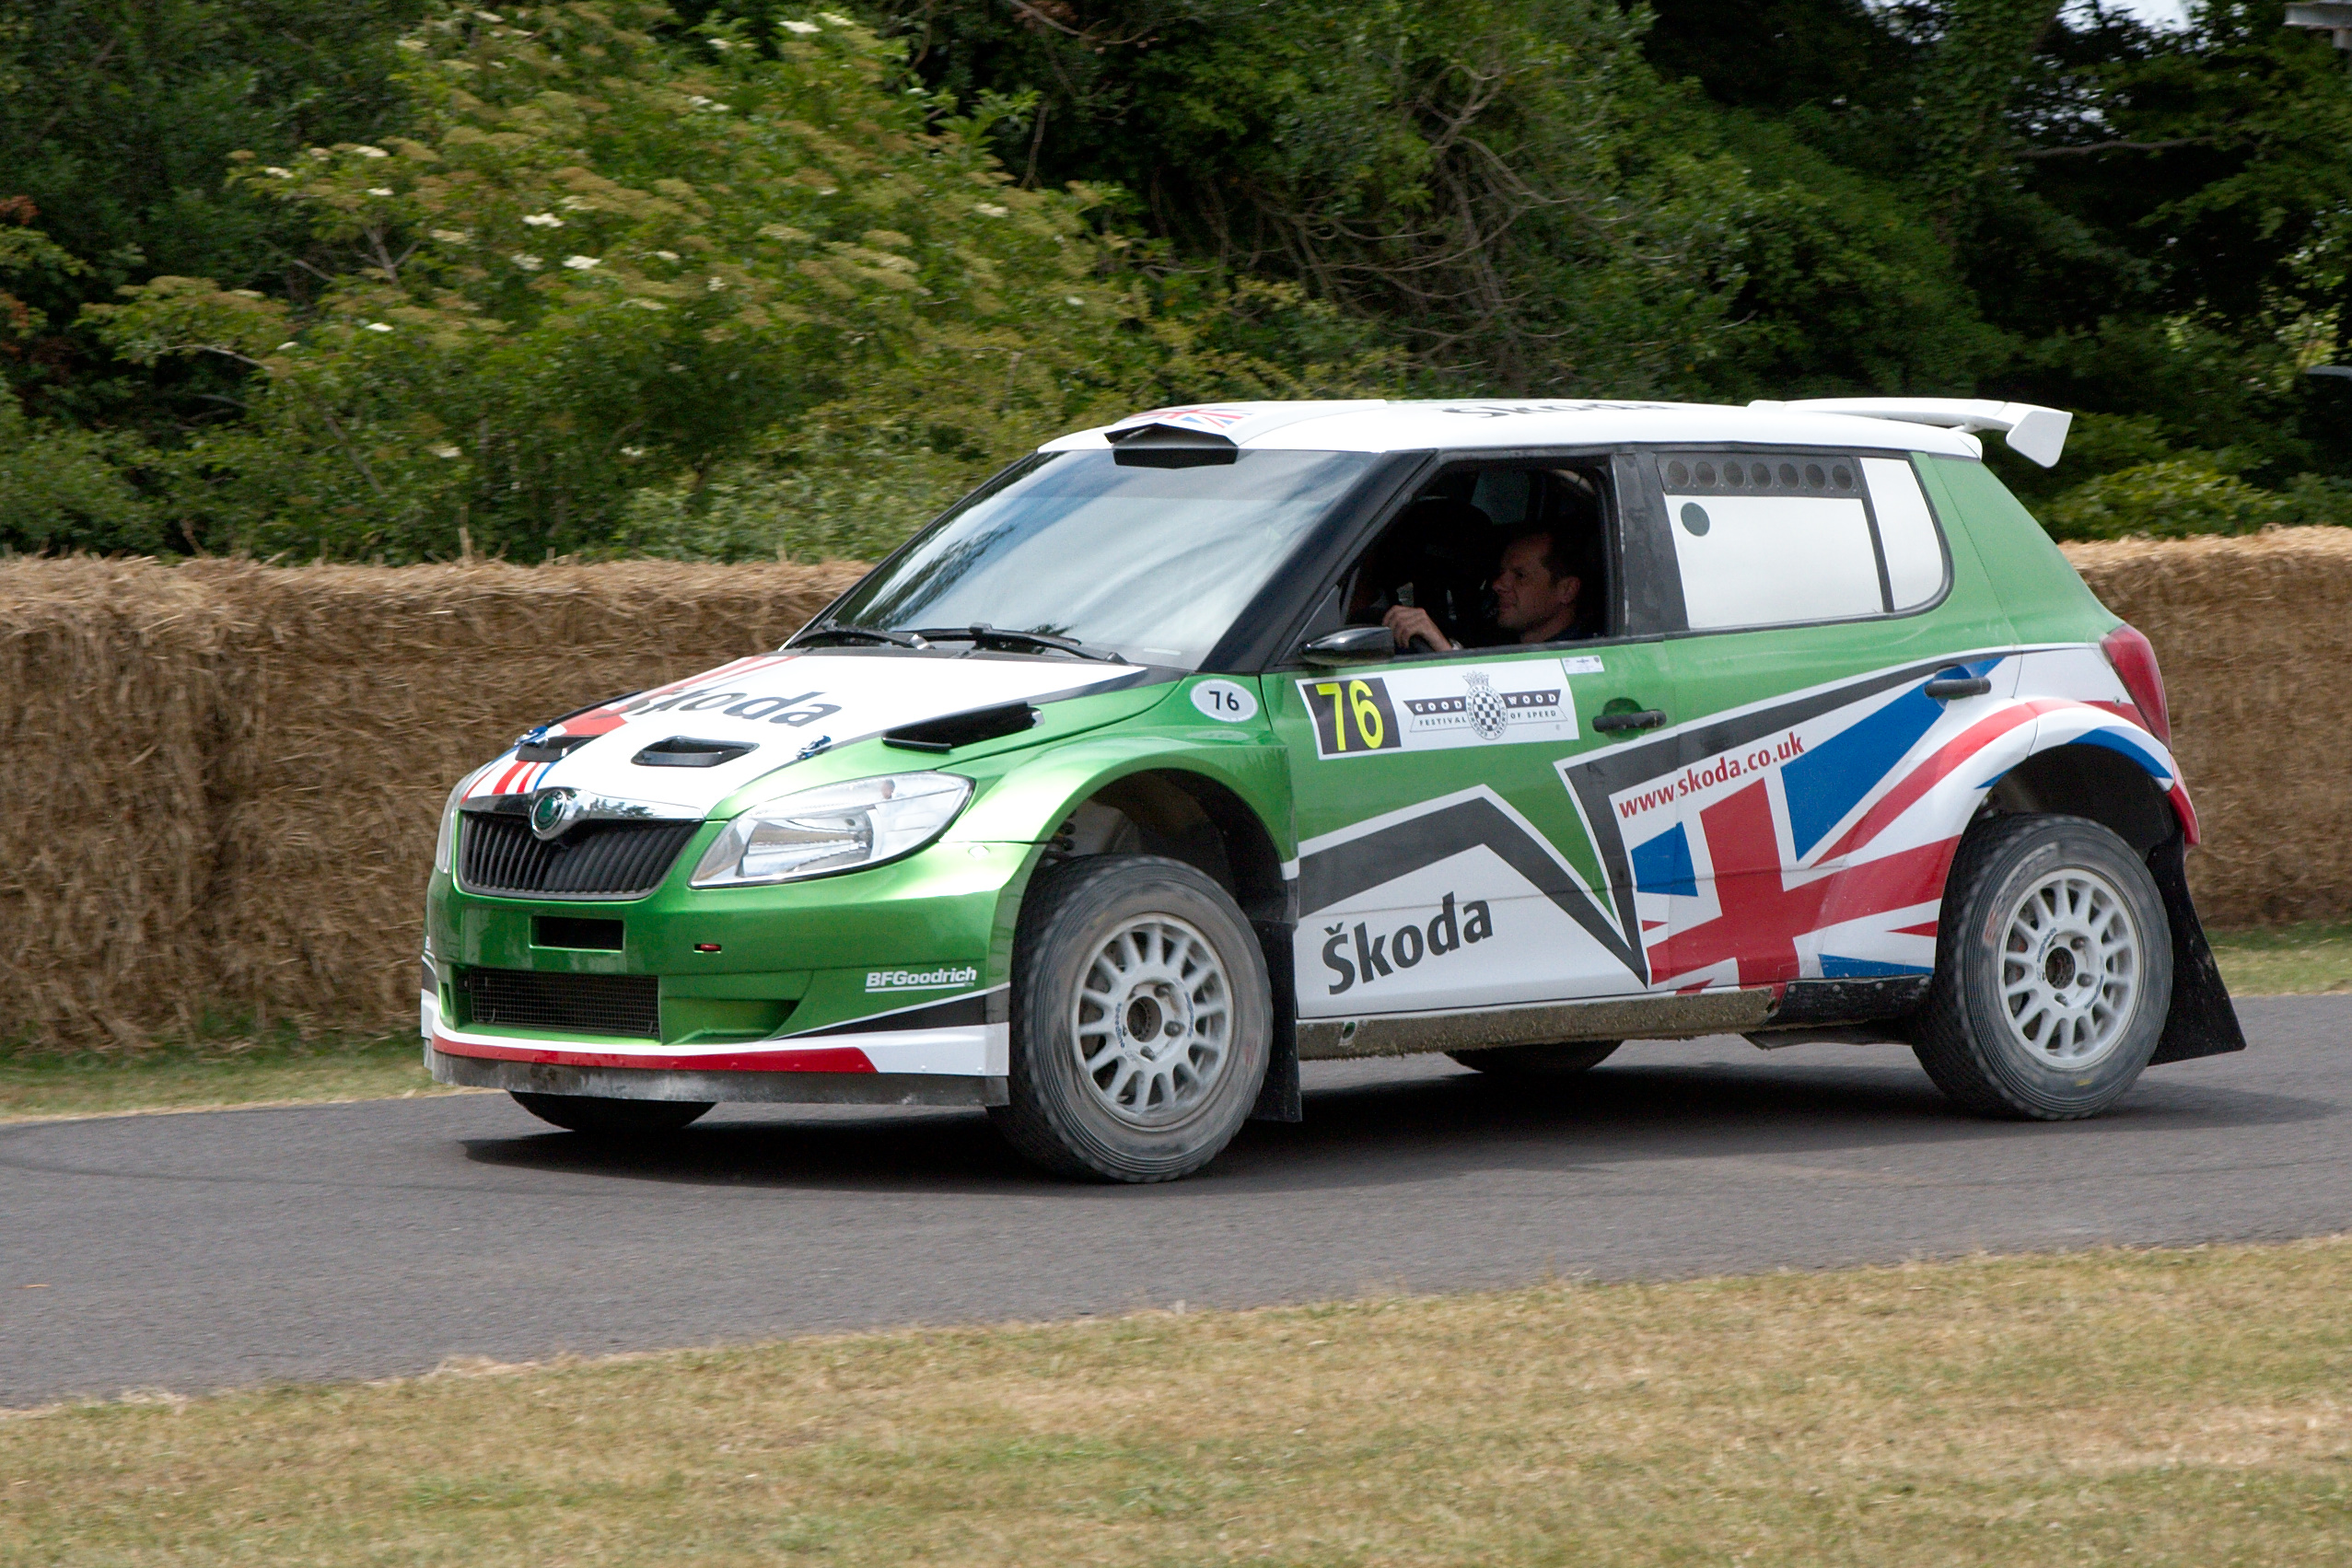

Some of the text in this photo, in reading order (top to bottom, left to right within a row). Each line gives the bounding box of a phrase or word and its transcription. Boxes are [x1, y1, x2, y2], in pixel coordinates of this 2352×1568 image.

[1208, 690, 1240, 712] 76
[1315, 679, 1384, 751] 76
[1419, 709, 1557, 727] FESTIVAL OF SPEED
[1618, 731, 1805, 819] www.skoda.co.uk
[1322, 890, 1494, 995] Škoda
[866, 966, 977, 987] BFGoodrich
